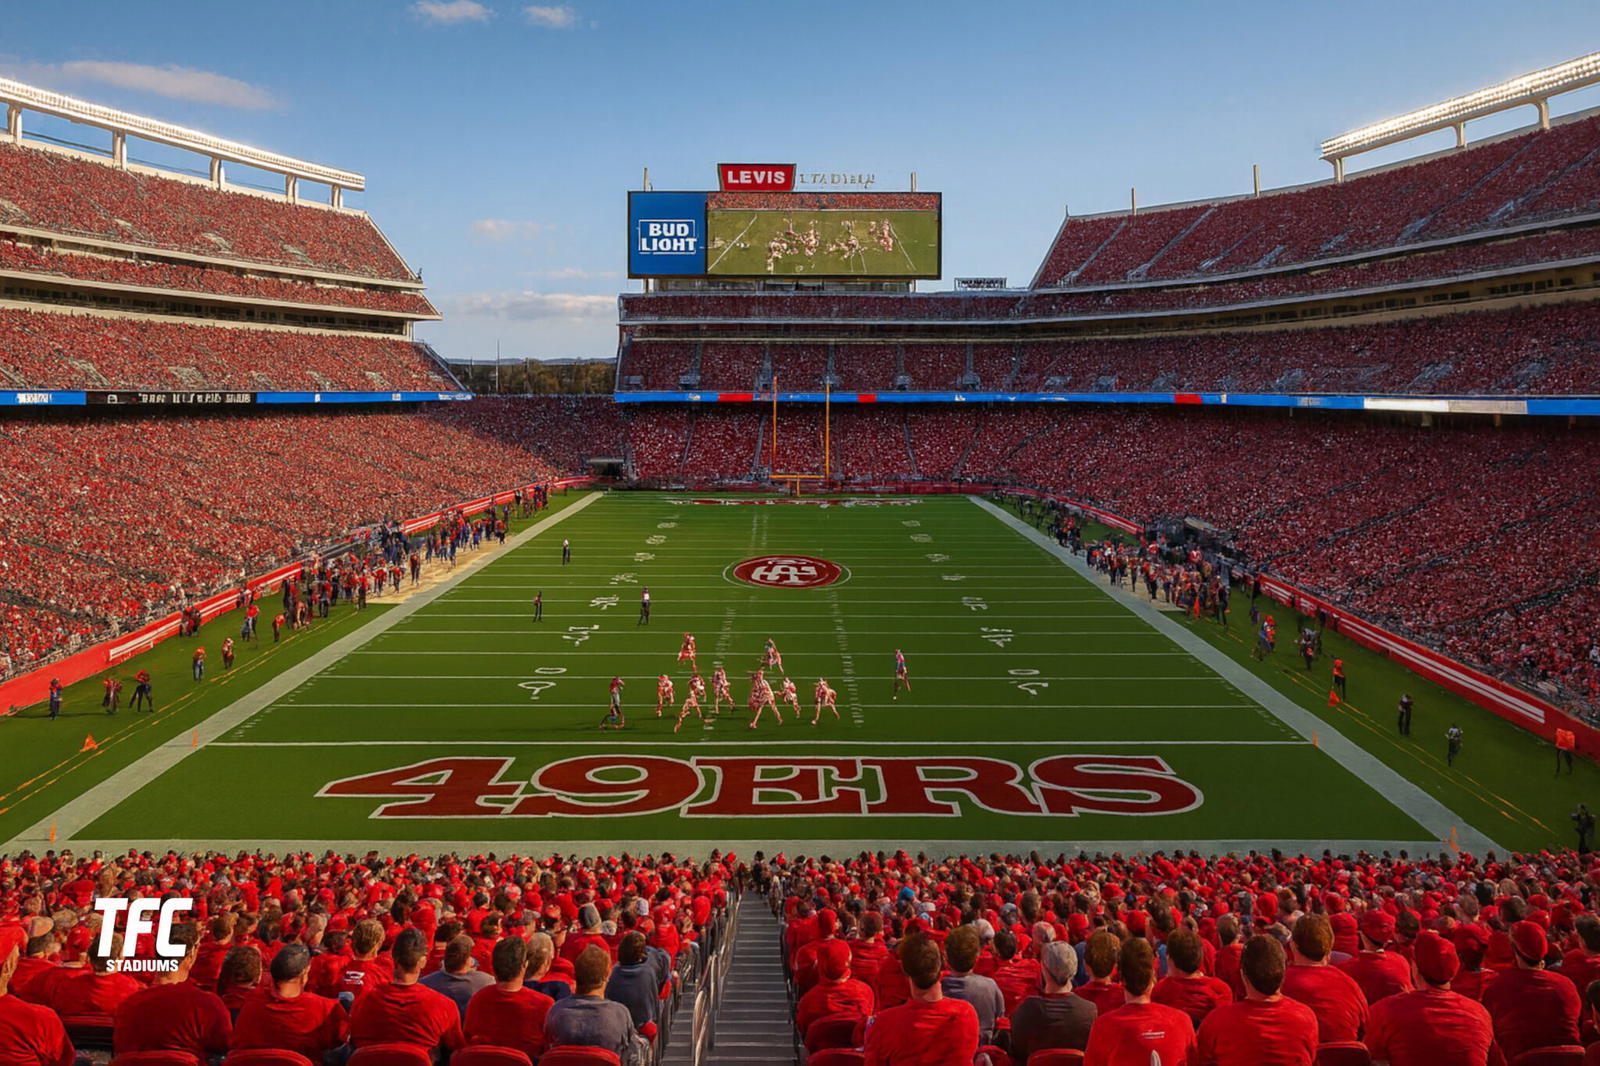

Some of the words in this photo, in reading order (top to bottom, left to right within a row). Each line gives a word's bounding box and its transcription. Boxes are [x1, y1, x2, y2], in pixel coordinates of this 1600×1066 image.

[727, 170, 785, 184] LEVIS
[649, 223, 690, 237] BUD
[315, 756, 1204, 819] 49ERS
